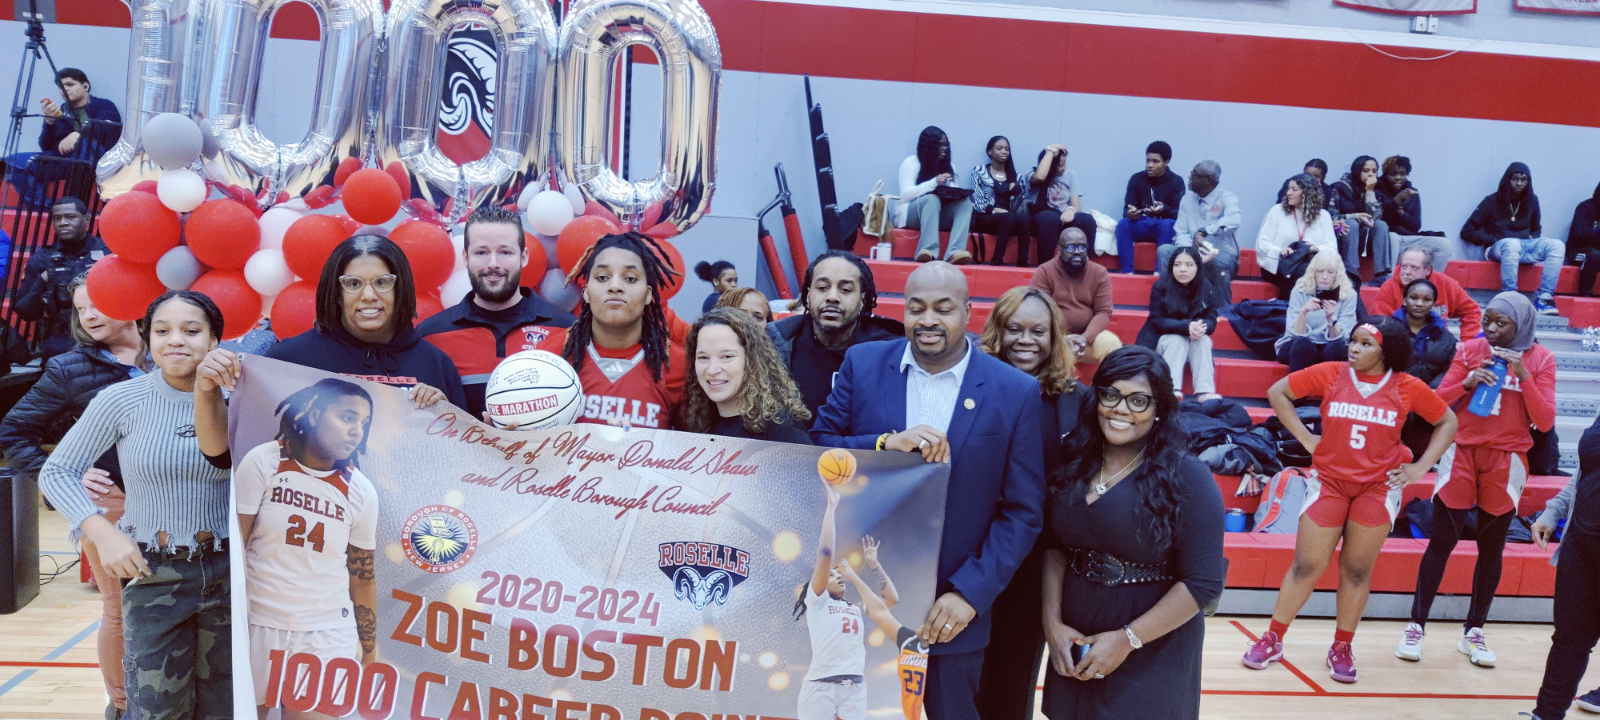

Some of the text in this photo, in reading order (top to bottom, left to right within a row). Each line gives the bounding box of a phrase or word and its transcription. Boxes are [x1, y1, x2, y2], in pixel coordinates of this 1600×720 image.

[488, 395, 558, 416] THE MARATHON
[577, 393, 661, 429] SELLE
[1327, 401, 1399, 427] ROSELLE
[426, 412, 760, 476] On Behalf of Mayor Donald Shaw
[1349, 424, 1369, 450] 5
[270, 486, 345, 523] ROSELLE
[461, 466, 732, 520] and Roselle Borough Council
[285, 513, 326, 554] 24
[402, 505, 477, 552] BOROUGH OF ROSELLE
[405, 548, 424, 567] NEW
[425, 559, 465, 573] JERSEY
[659, 542, 750, 577] ROSELLE
[476, 570, 663, 627] 2020-2024
[390, 588, 738, 692] ZOE BOSTON
[841, 616, 859, 635] 24
[264, 649, 401, 720] 1000
[902, 669, 925, 697] 23
